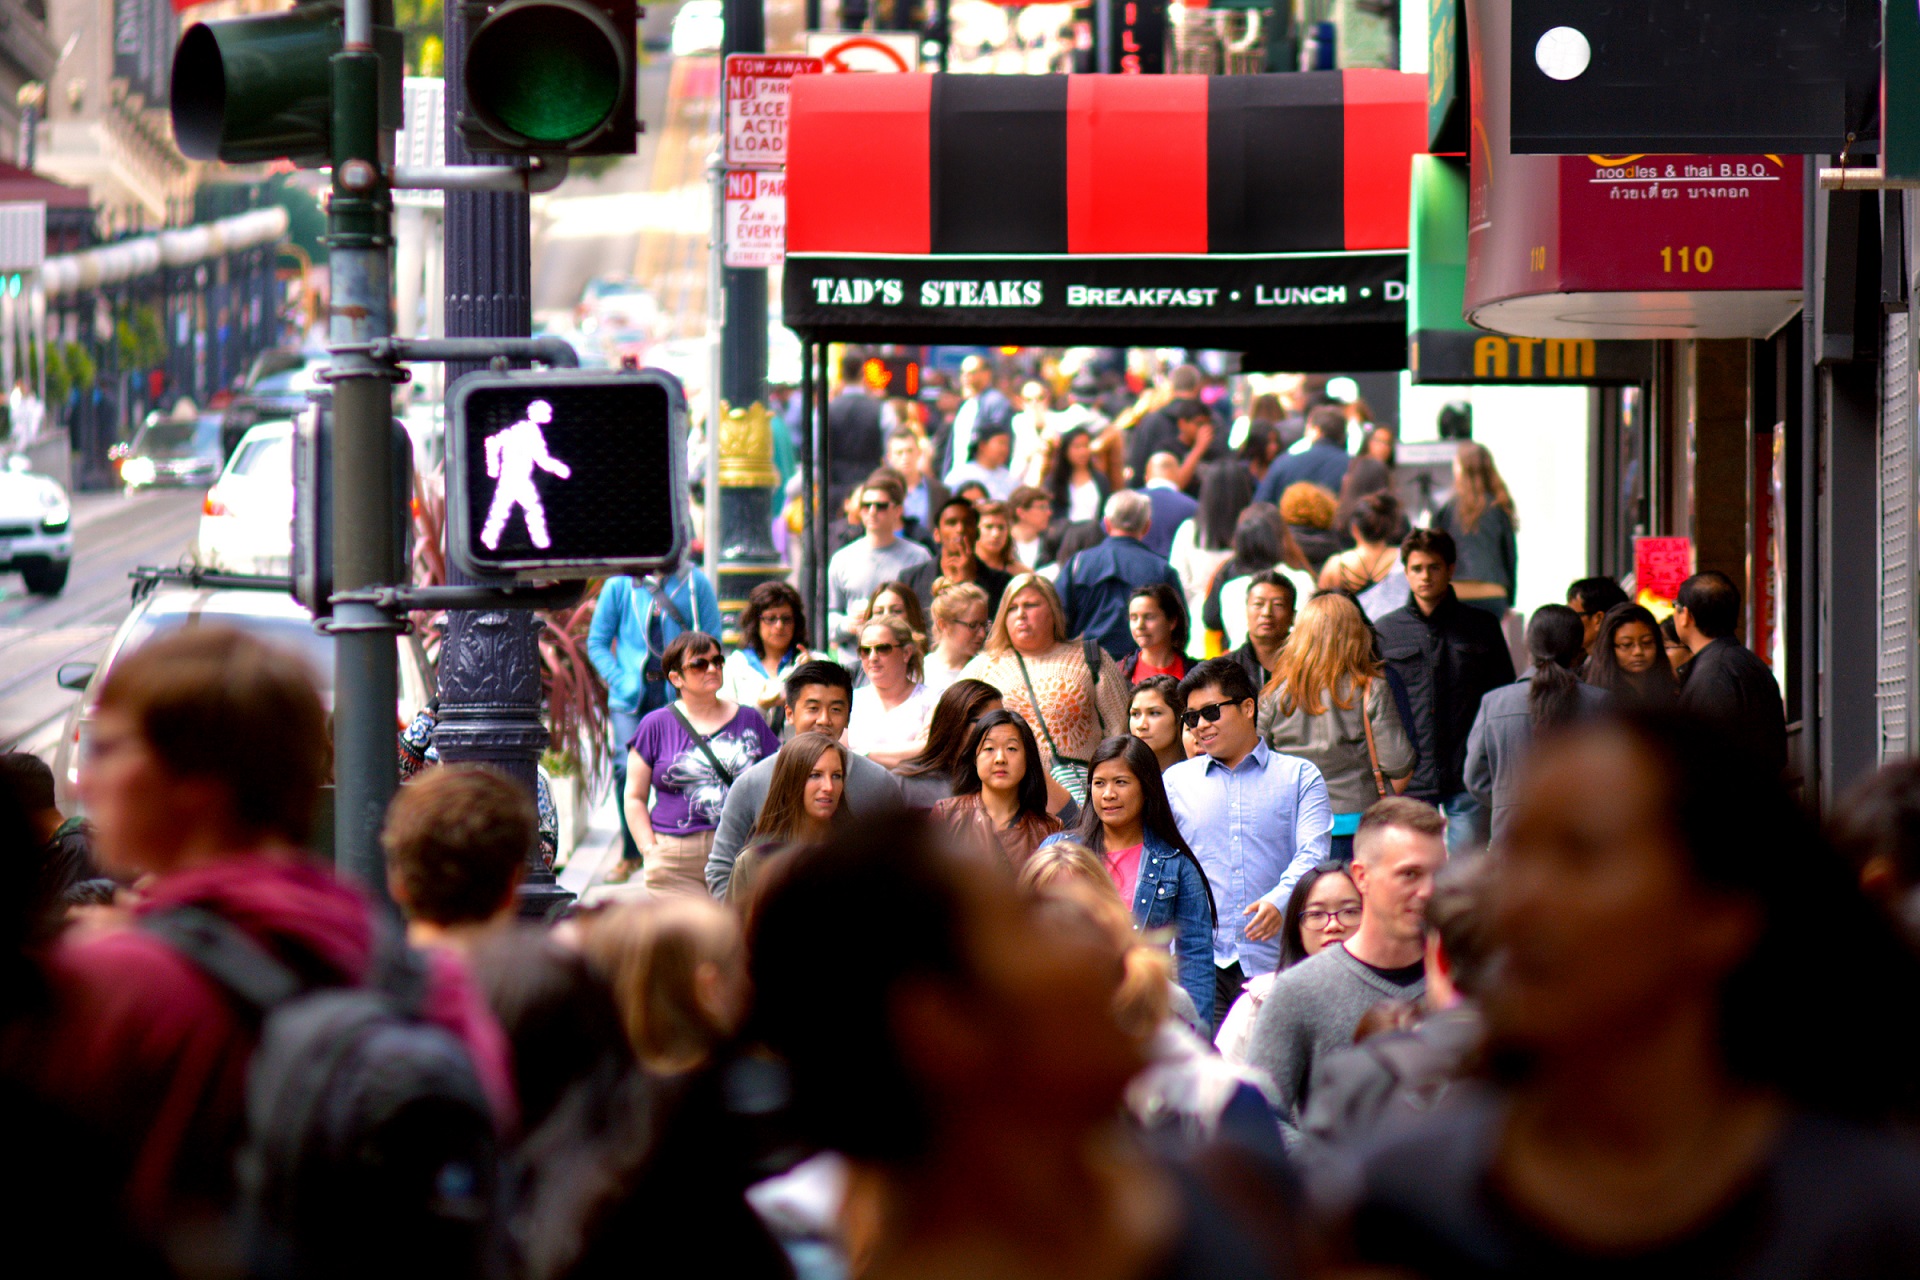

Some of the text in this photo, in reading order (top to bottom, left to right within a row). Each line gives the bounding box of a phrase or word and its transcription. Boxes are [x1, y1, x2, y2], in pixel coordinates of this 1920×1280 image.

[736, 60, 813, 74] TOW-AWAY
[730, 76, 755, 99] NO
[740, 102, 785, 116] EXCE
[735, 137, 783, 151] LOAD
[1596, 163, 1770, 179] noodles & thai B.B.Q.
[729, 174, 786, 197] NO PAR
[1687, 187, 1749, 198] บางกอก
[737, 224, 786, 239] EVERY
[1531, 246, 1546, 272] 110
[1660, 245, 1713, 273] 110
[812, 278, 902, 304] TAD'S
[921, 280, 1042, 306] STEAKS
[1474, 335, 1595, 377] ATM
